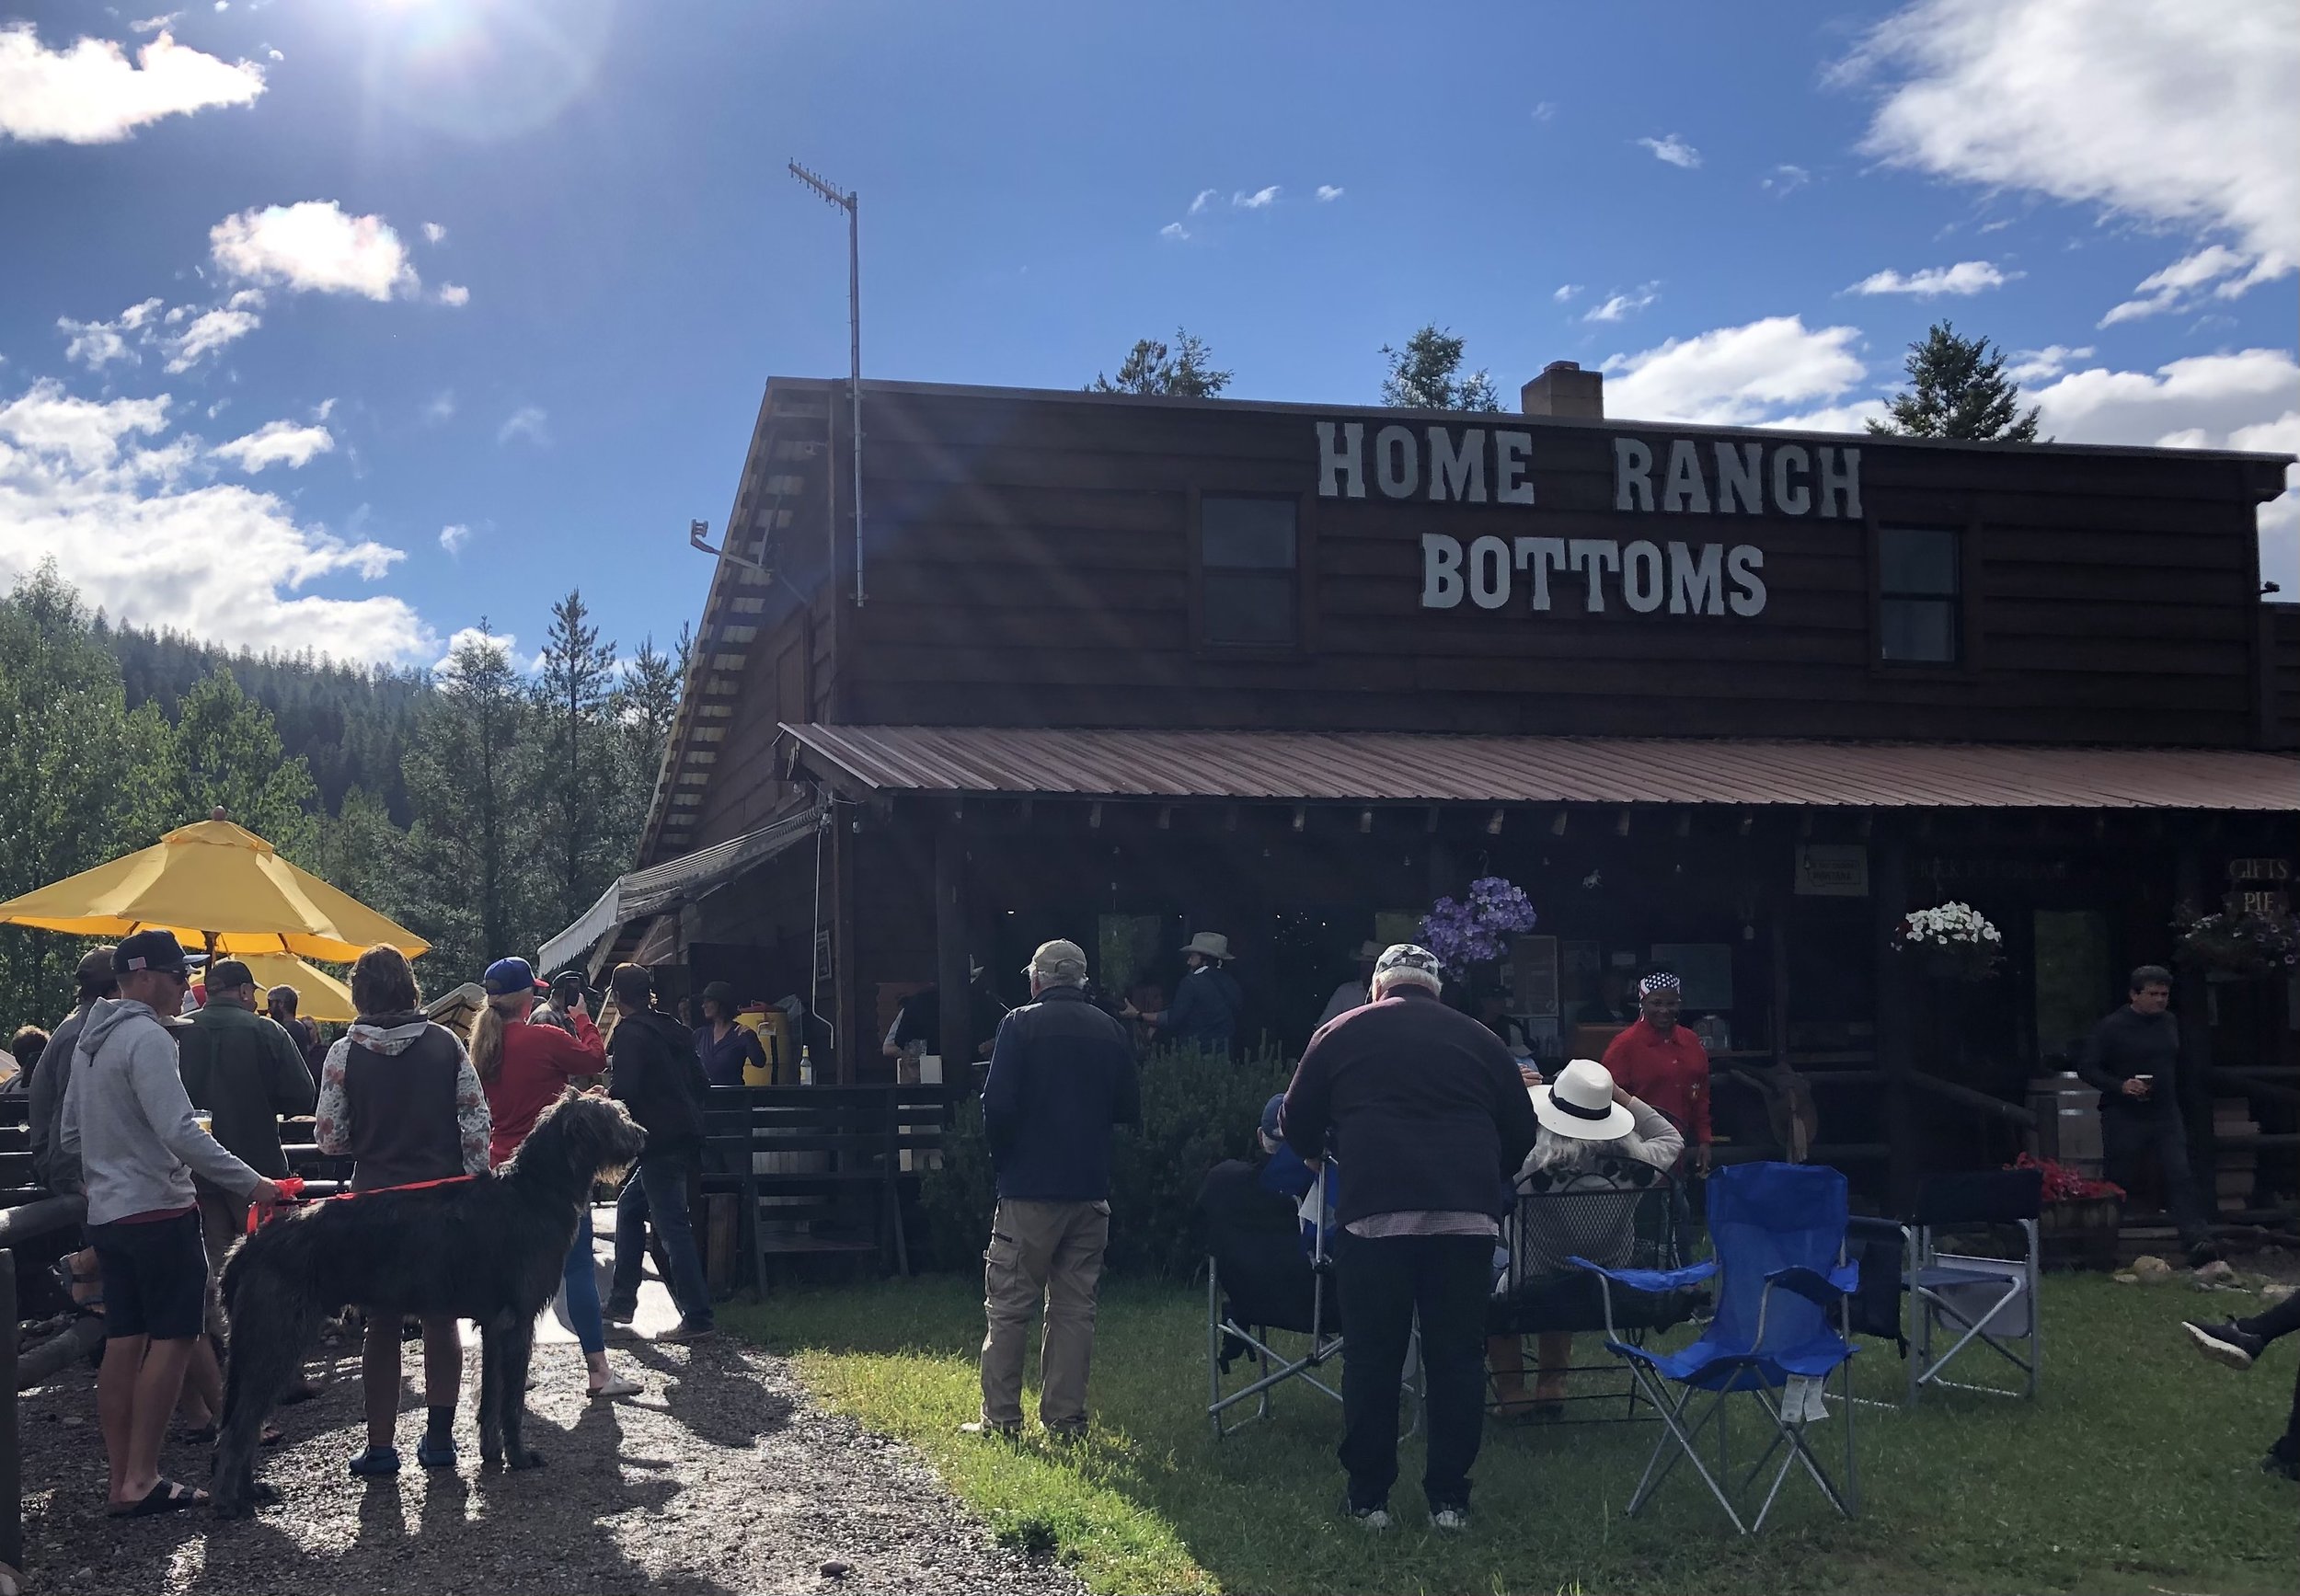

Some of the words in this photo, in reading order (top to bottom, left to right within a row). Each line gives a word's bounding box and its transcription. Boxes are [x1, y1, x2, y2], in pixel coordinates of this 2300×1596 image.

[1316, 421, 1535, 506] HOME
[1613, 437, 1864, 520] RANCH
[1420, 532, 1767, 617] BOTTOMS
[2229, 857, 2289, 879] GIFTS
[2243, 890, 2275, 913] PIE
